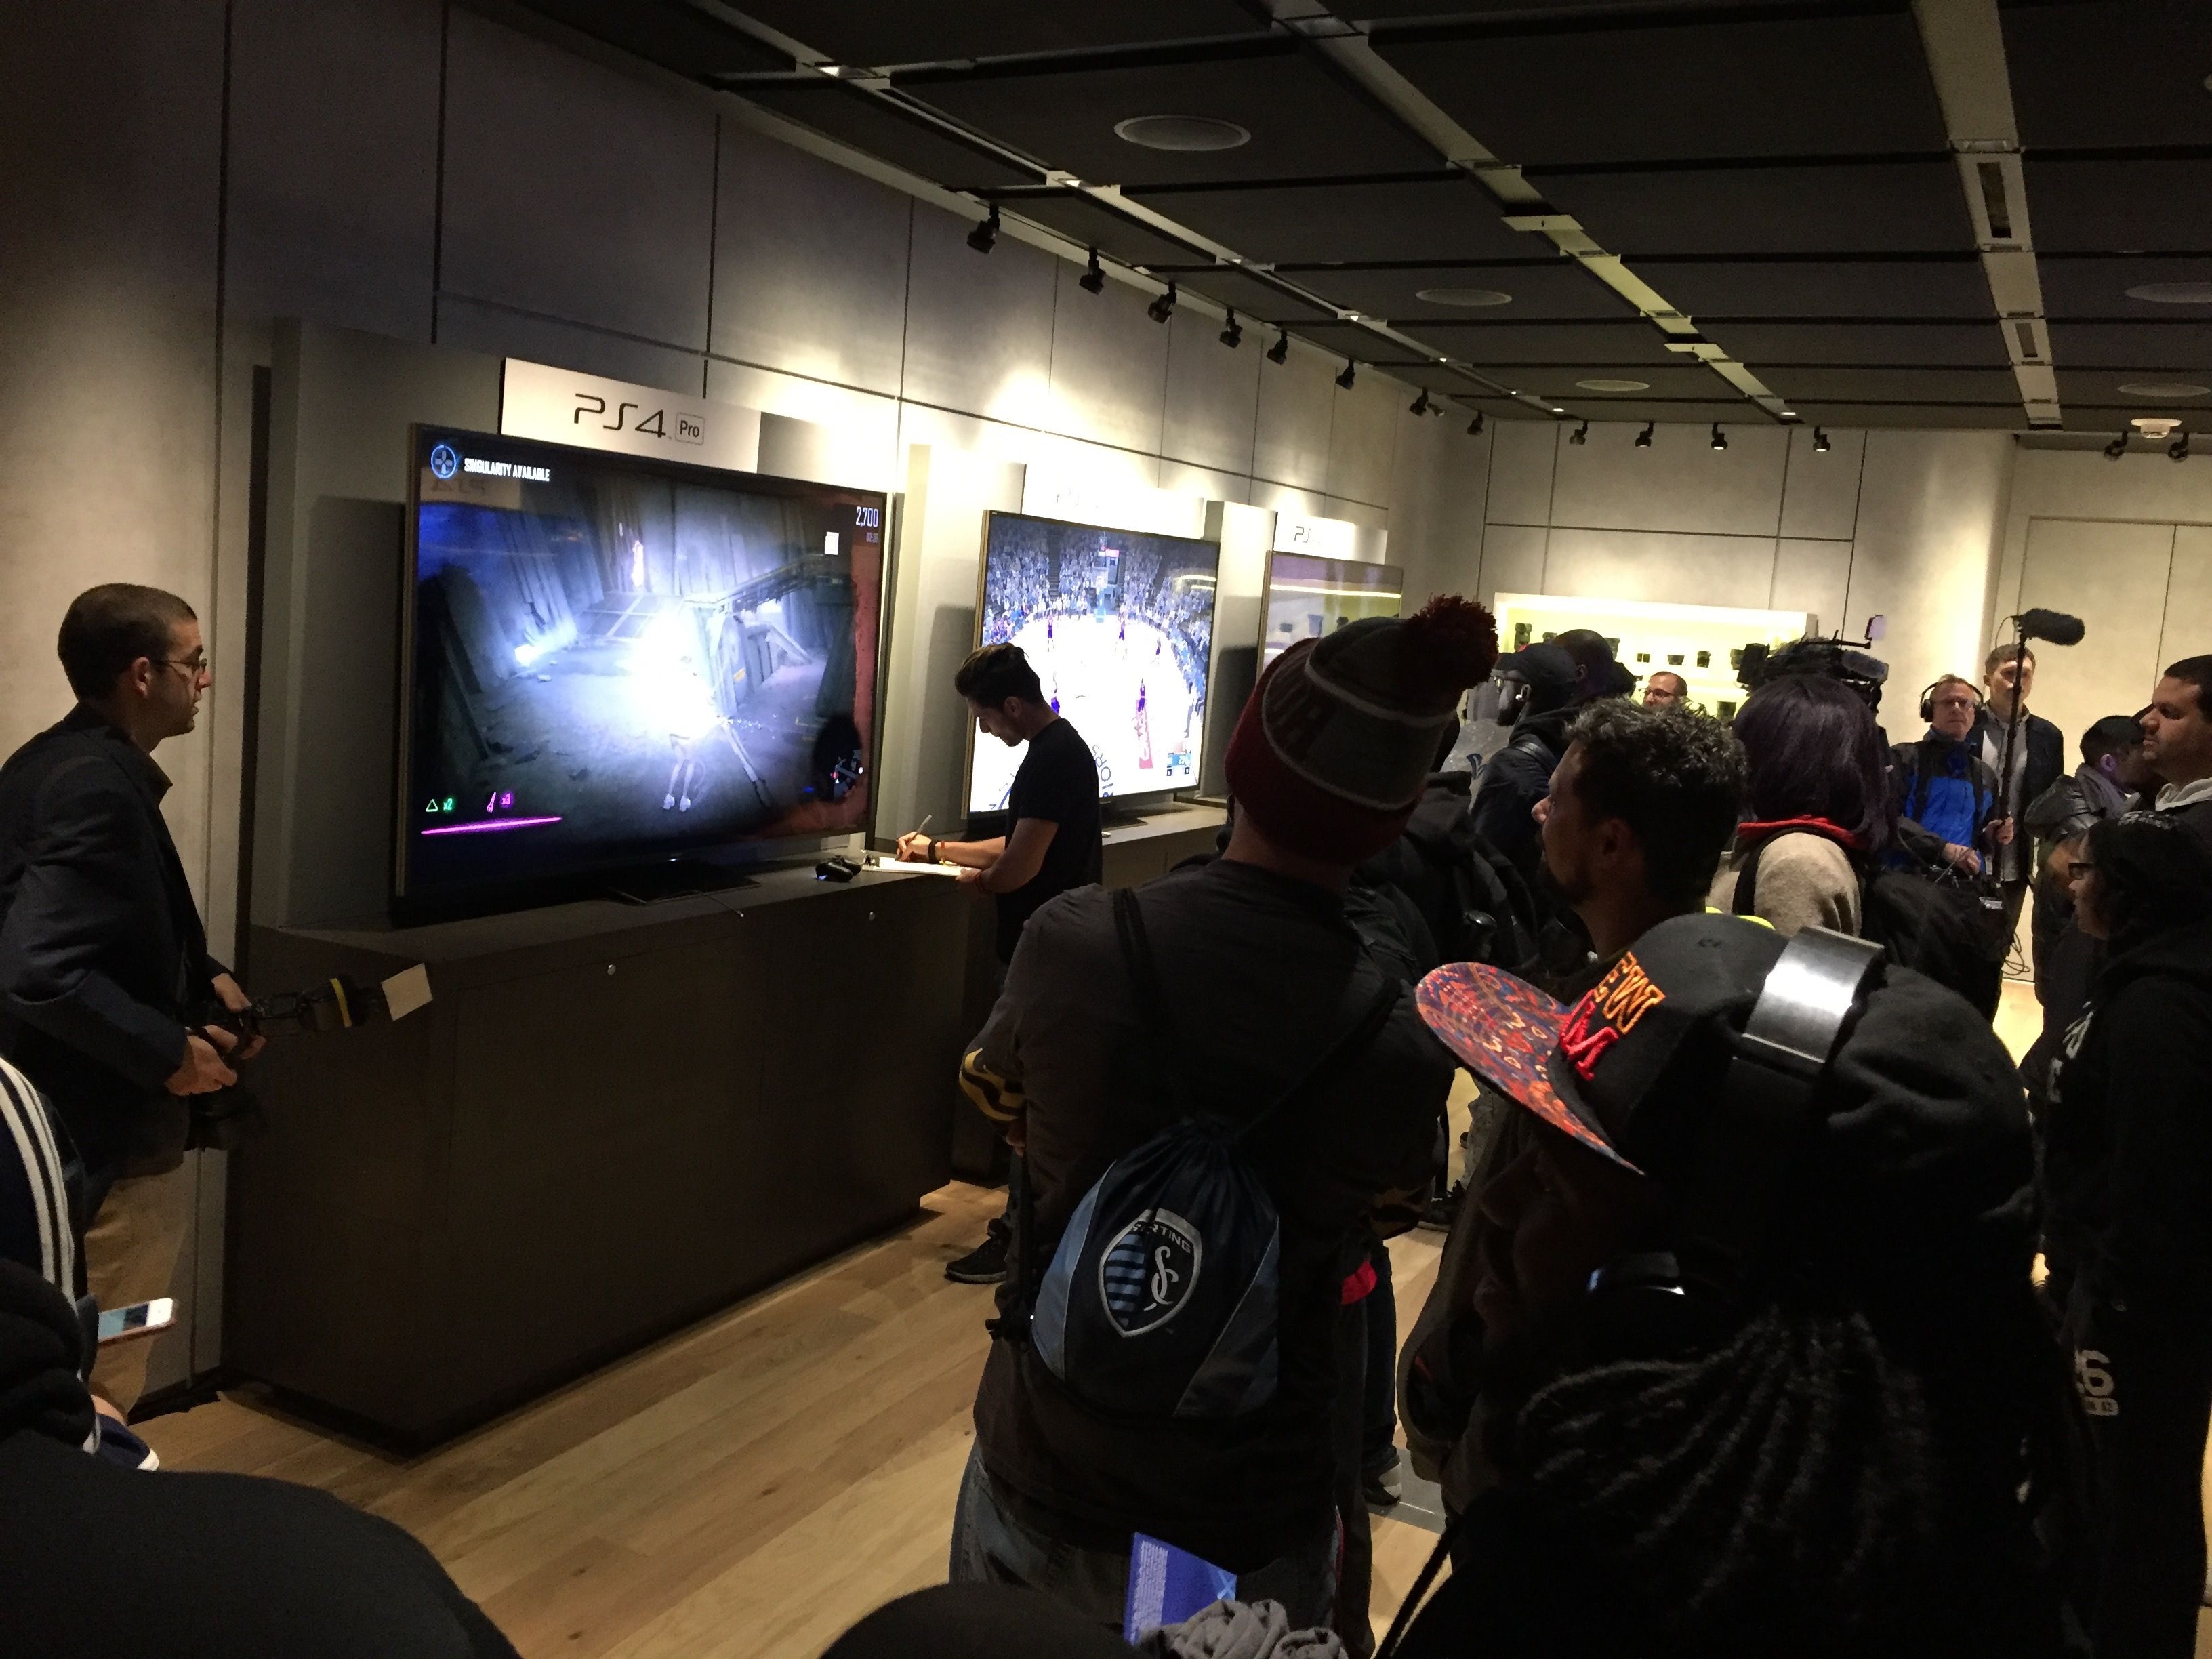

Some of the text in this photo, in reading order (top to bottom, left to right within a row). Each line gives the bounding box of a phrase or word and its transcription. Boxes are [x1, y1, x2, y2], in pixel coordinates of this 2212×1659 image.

[573, 393, 701, 438] PS4 Pro
[464, 457, 550, 483] SINGULARITY AVAILABLE
[855, 506, 879, 527] 2,700
